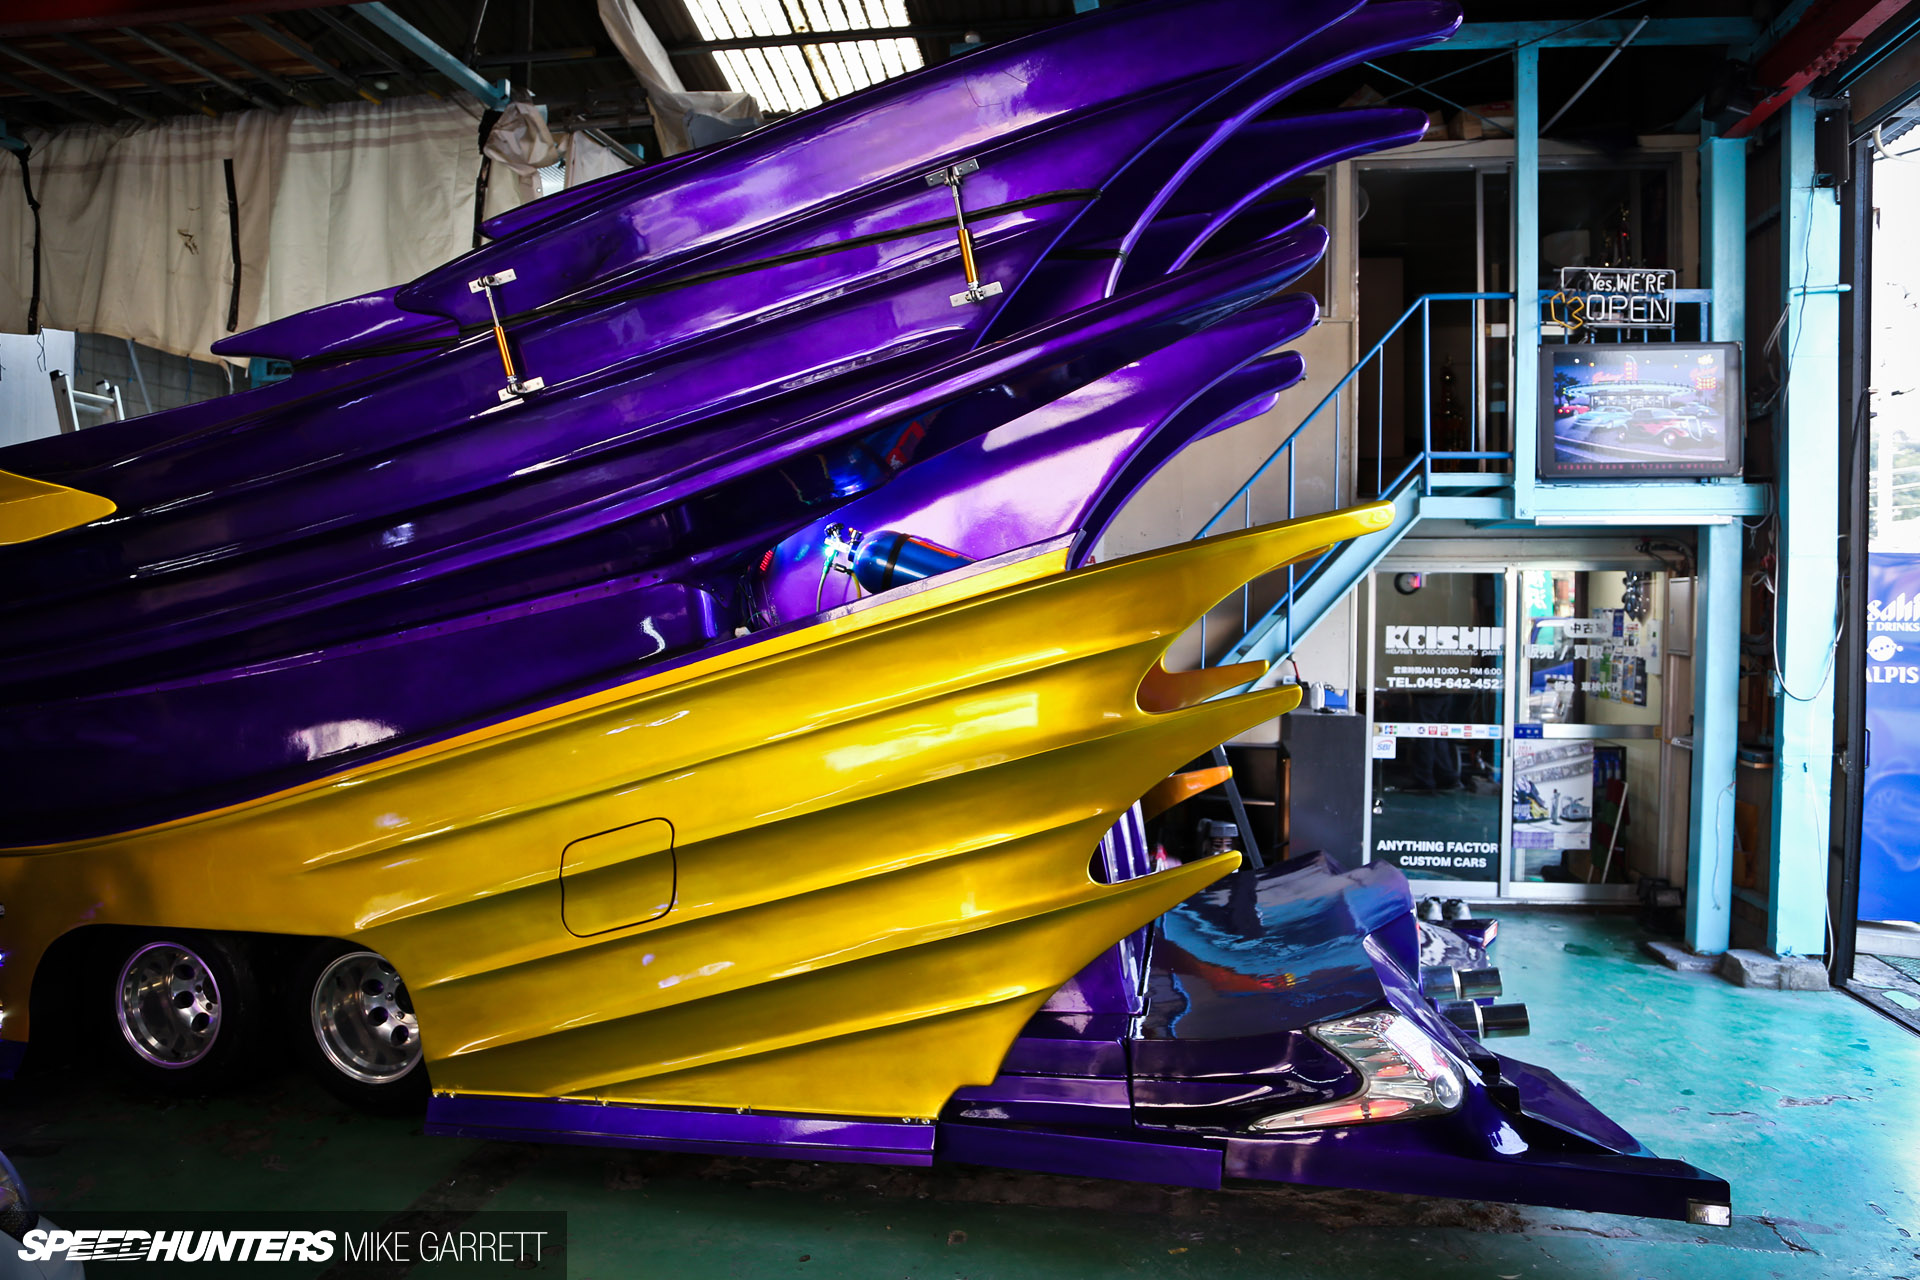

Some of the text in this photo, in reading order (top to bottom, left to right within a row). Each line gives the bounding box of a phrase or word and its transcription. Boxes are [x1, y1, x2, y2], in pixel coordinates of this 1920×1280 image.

[1617, 273, 1667, 294] WE'RE
[1586, 294, 1670, 322] OPEN
[1876, 622, 1920, 632] DRINKS
[1437, 667, 1459, 675] 10:00
[1469, 667, 1482, 675] PM
[1484, 667, 1502, 676] 6:00
[1377, 840, 1498, 853] ANYTHING FACTOR
[1400, 855, 1487, 868] CUSTOM CARS
